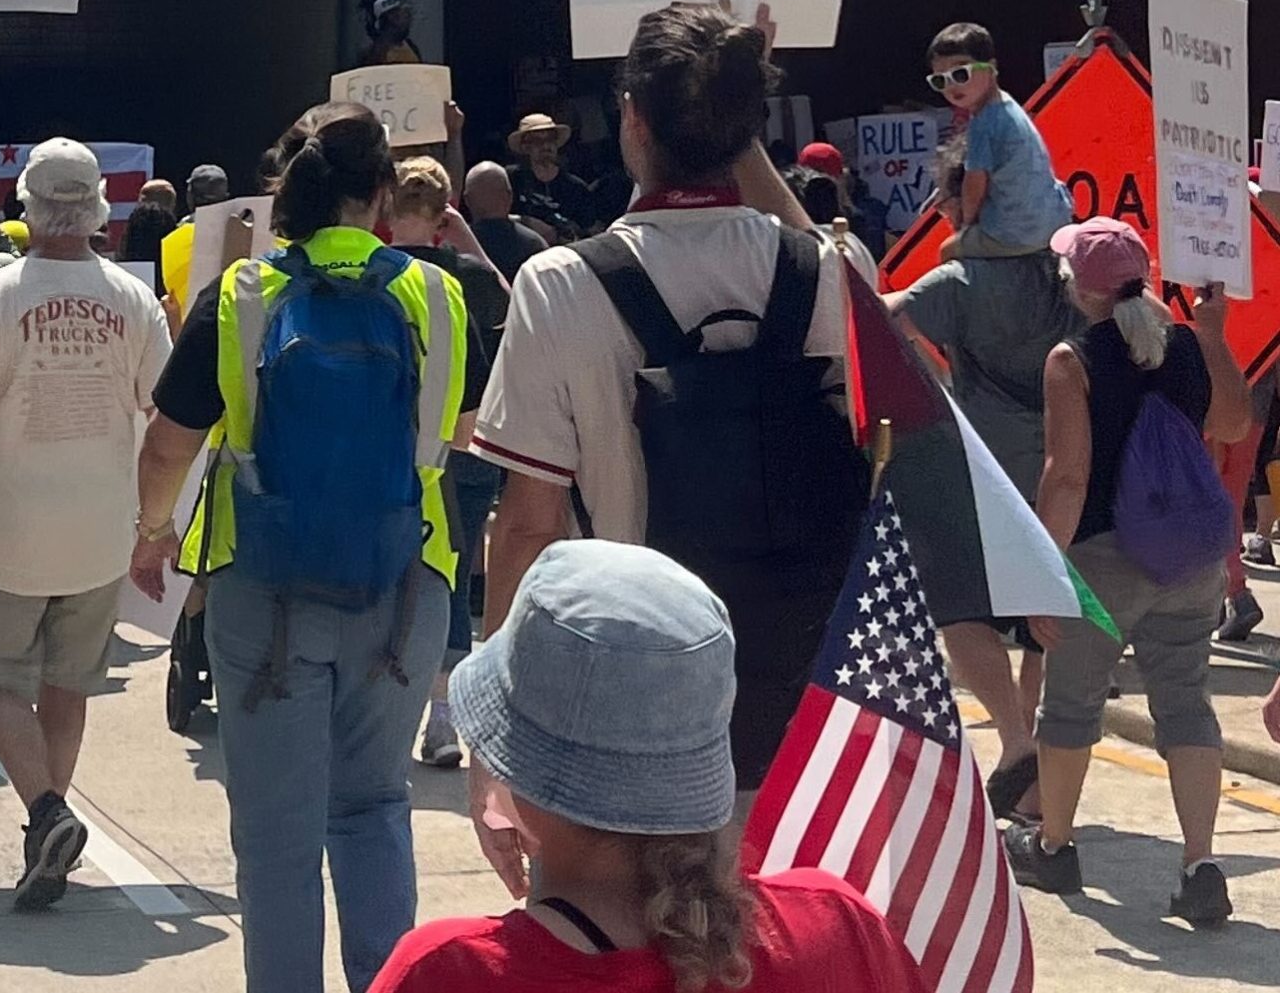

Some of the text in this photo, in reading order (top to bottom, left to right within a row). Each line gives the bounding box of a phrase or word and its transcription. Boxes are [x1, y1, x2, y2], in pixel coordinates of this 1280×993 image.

[1162, 26, 1232, 69] DISSENT
[347, 76, 395, 104] FREE
[380, 107, 419, 133] DC
[862, 121, 929, 155] RULE
[1162, 118, 1242, 163] PATRIOTIC
[884, 159, 908, 178] OF
[1067, 171, 1150, 229] OA
[19, 297, 125, 343] TEDESCHI
[37, 327, 110, 344] TRUCKS
[51, 345, 94, 356] BAND
